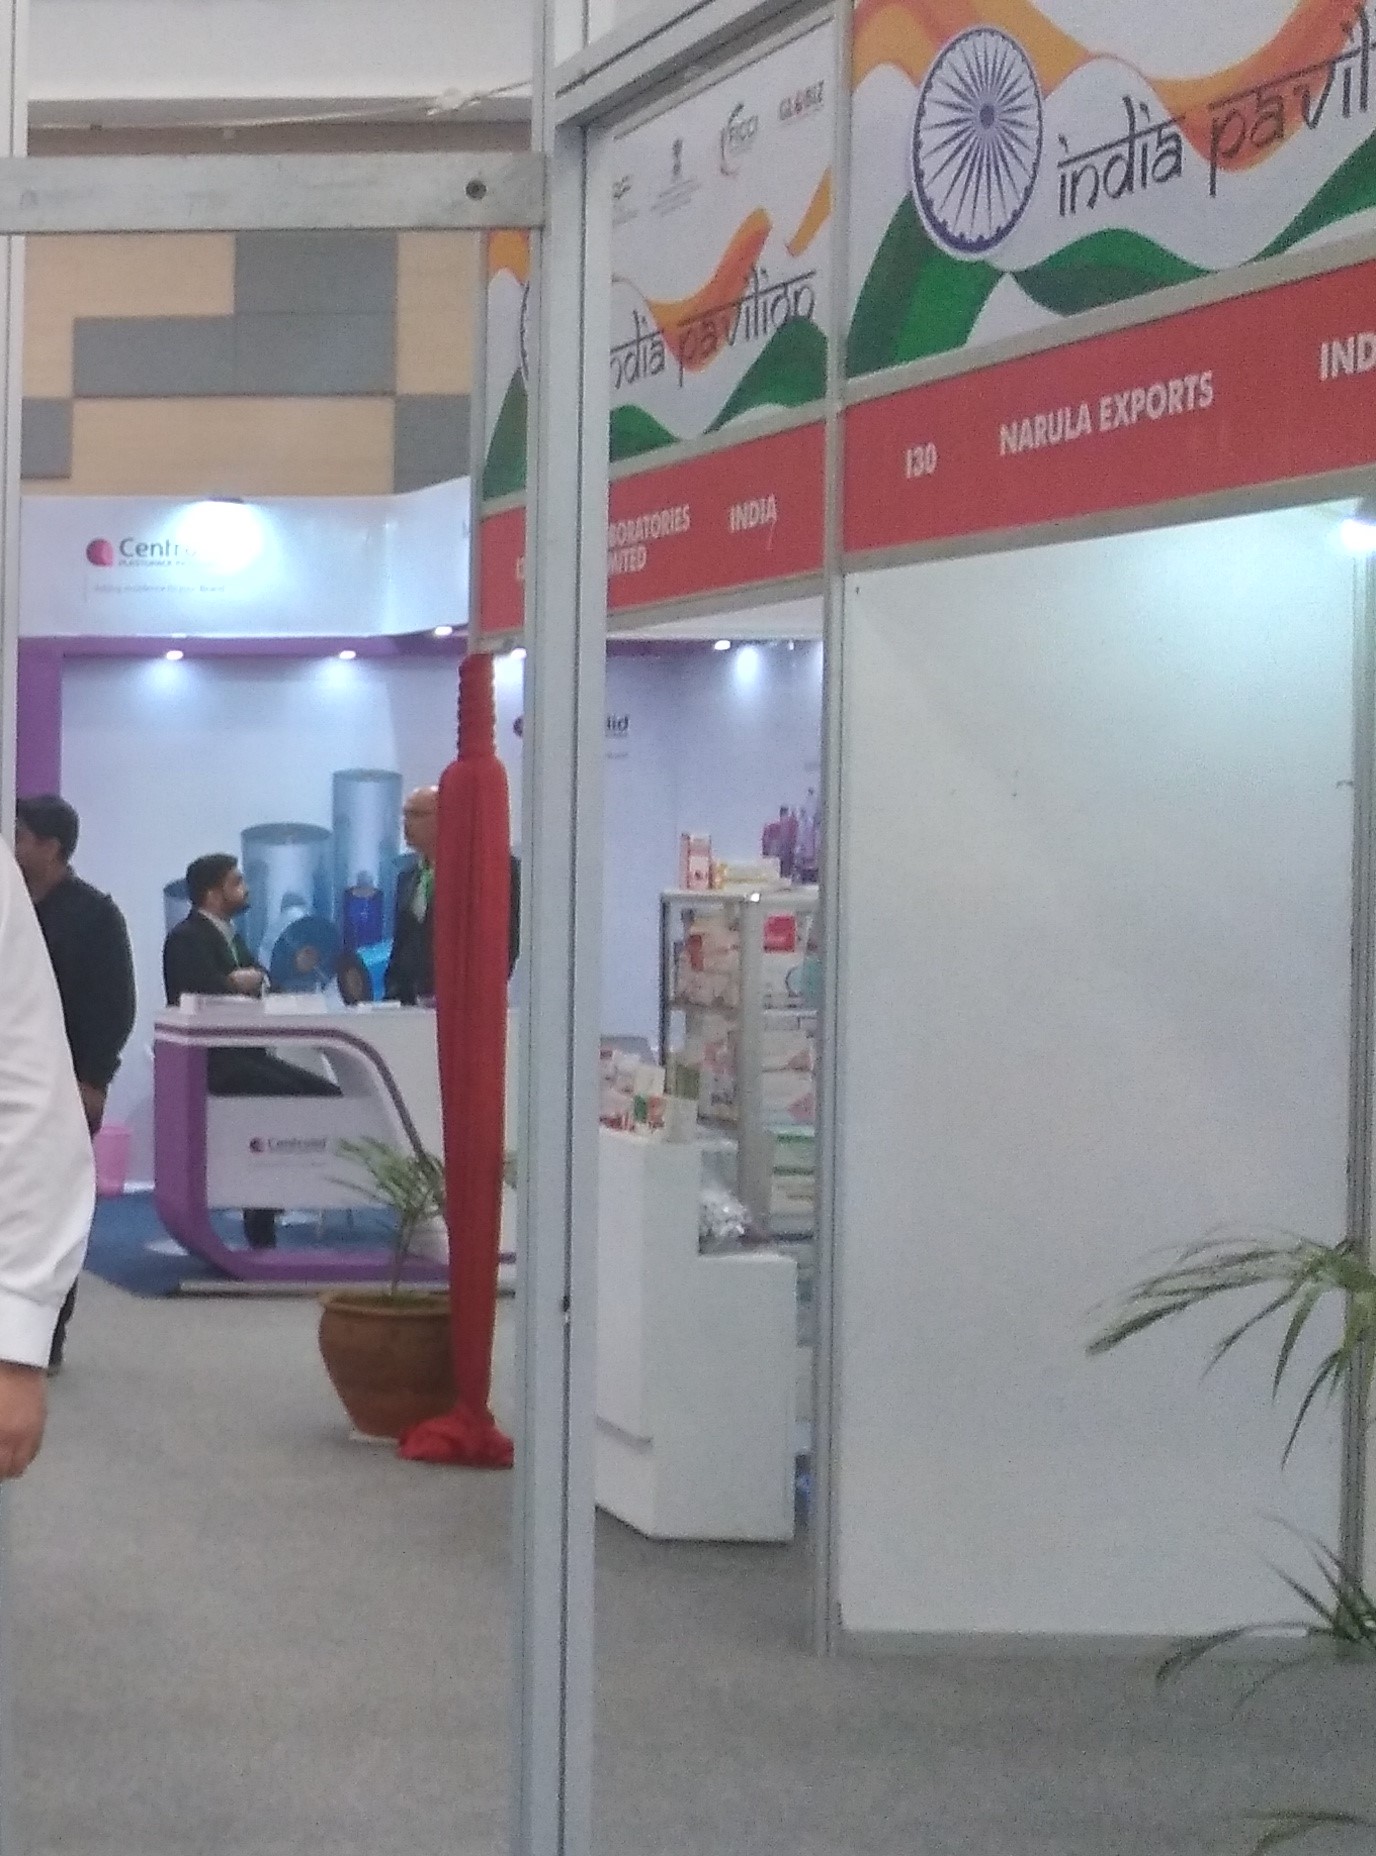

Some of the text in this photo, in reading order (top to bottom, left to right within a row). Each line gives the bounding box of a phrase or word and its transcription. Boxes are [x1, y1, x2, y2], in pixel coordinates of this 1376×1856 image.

[999, 403, 1092, 457] NARULA
[1098, 370, 1215, 431] EXPORTS
[729, 493, 778, 533] INDIA
